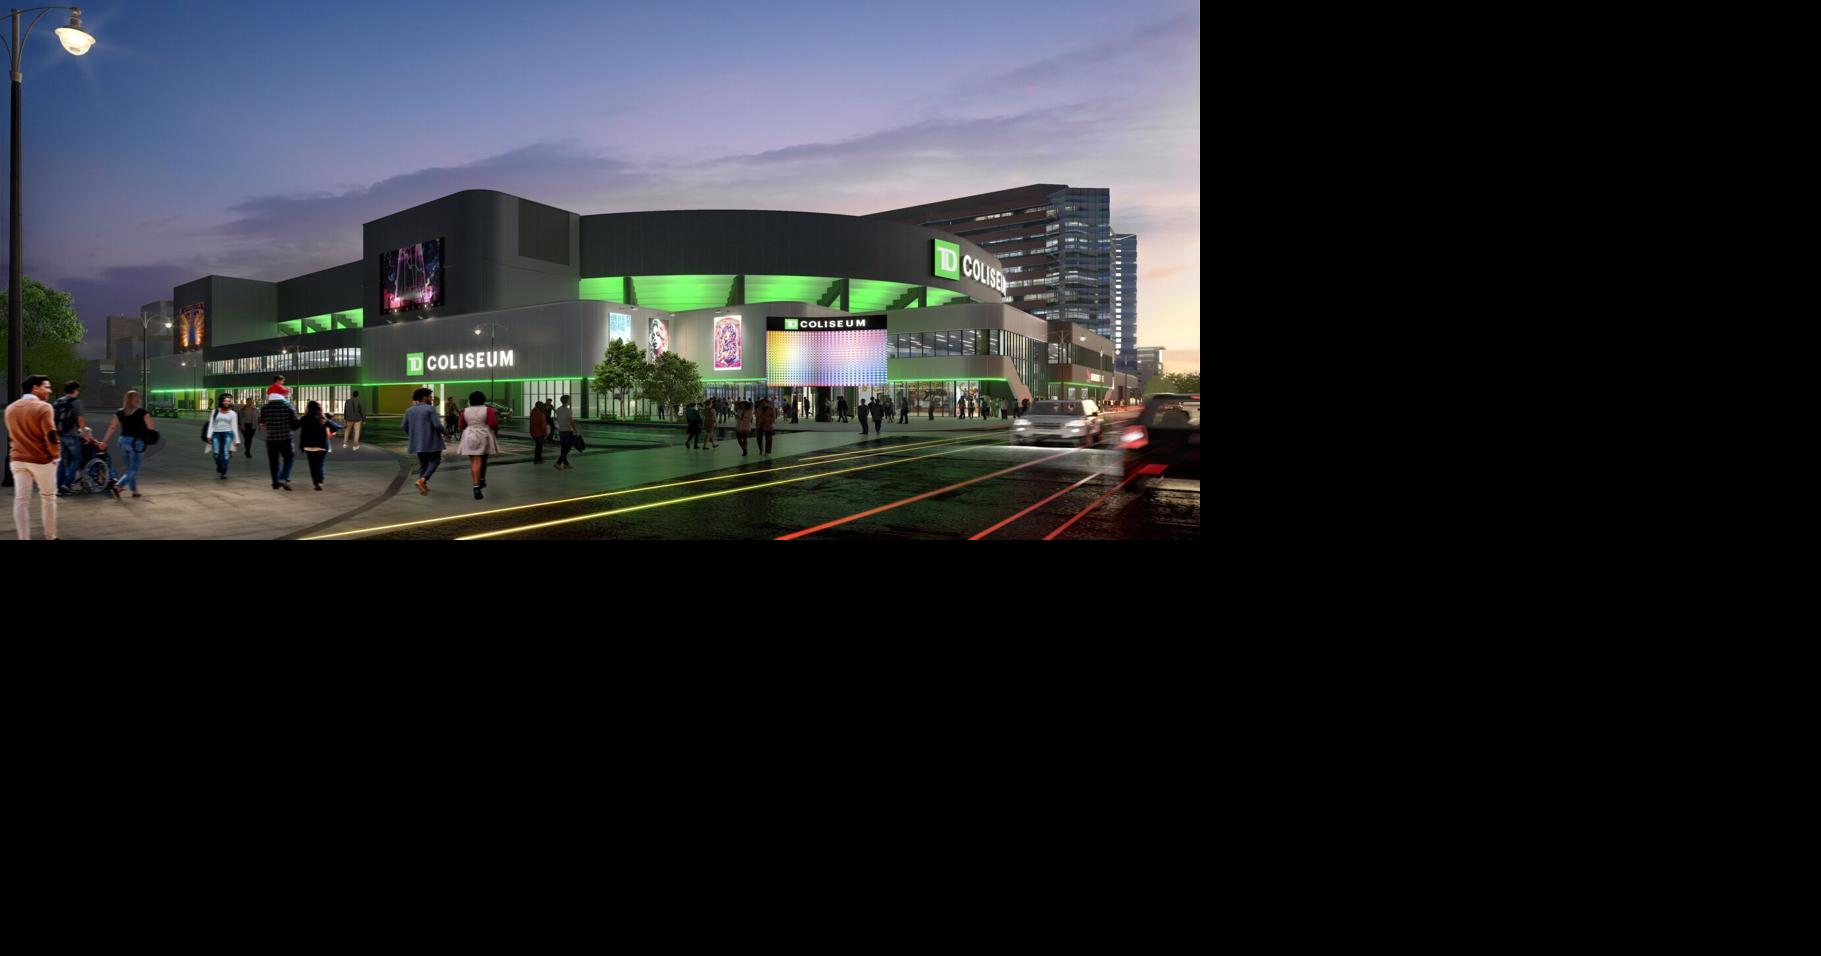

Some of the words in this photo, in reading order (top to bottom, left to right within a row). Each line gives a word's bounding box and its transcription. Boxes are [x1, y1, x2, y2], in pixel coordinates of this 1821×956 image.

[937, 246, 957, 272] TD
[800, 319, 866, 328] COLISEUM
[408, 357, 422, 371] TD
[427, 350, 514, 370] COLISEUM
